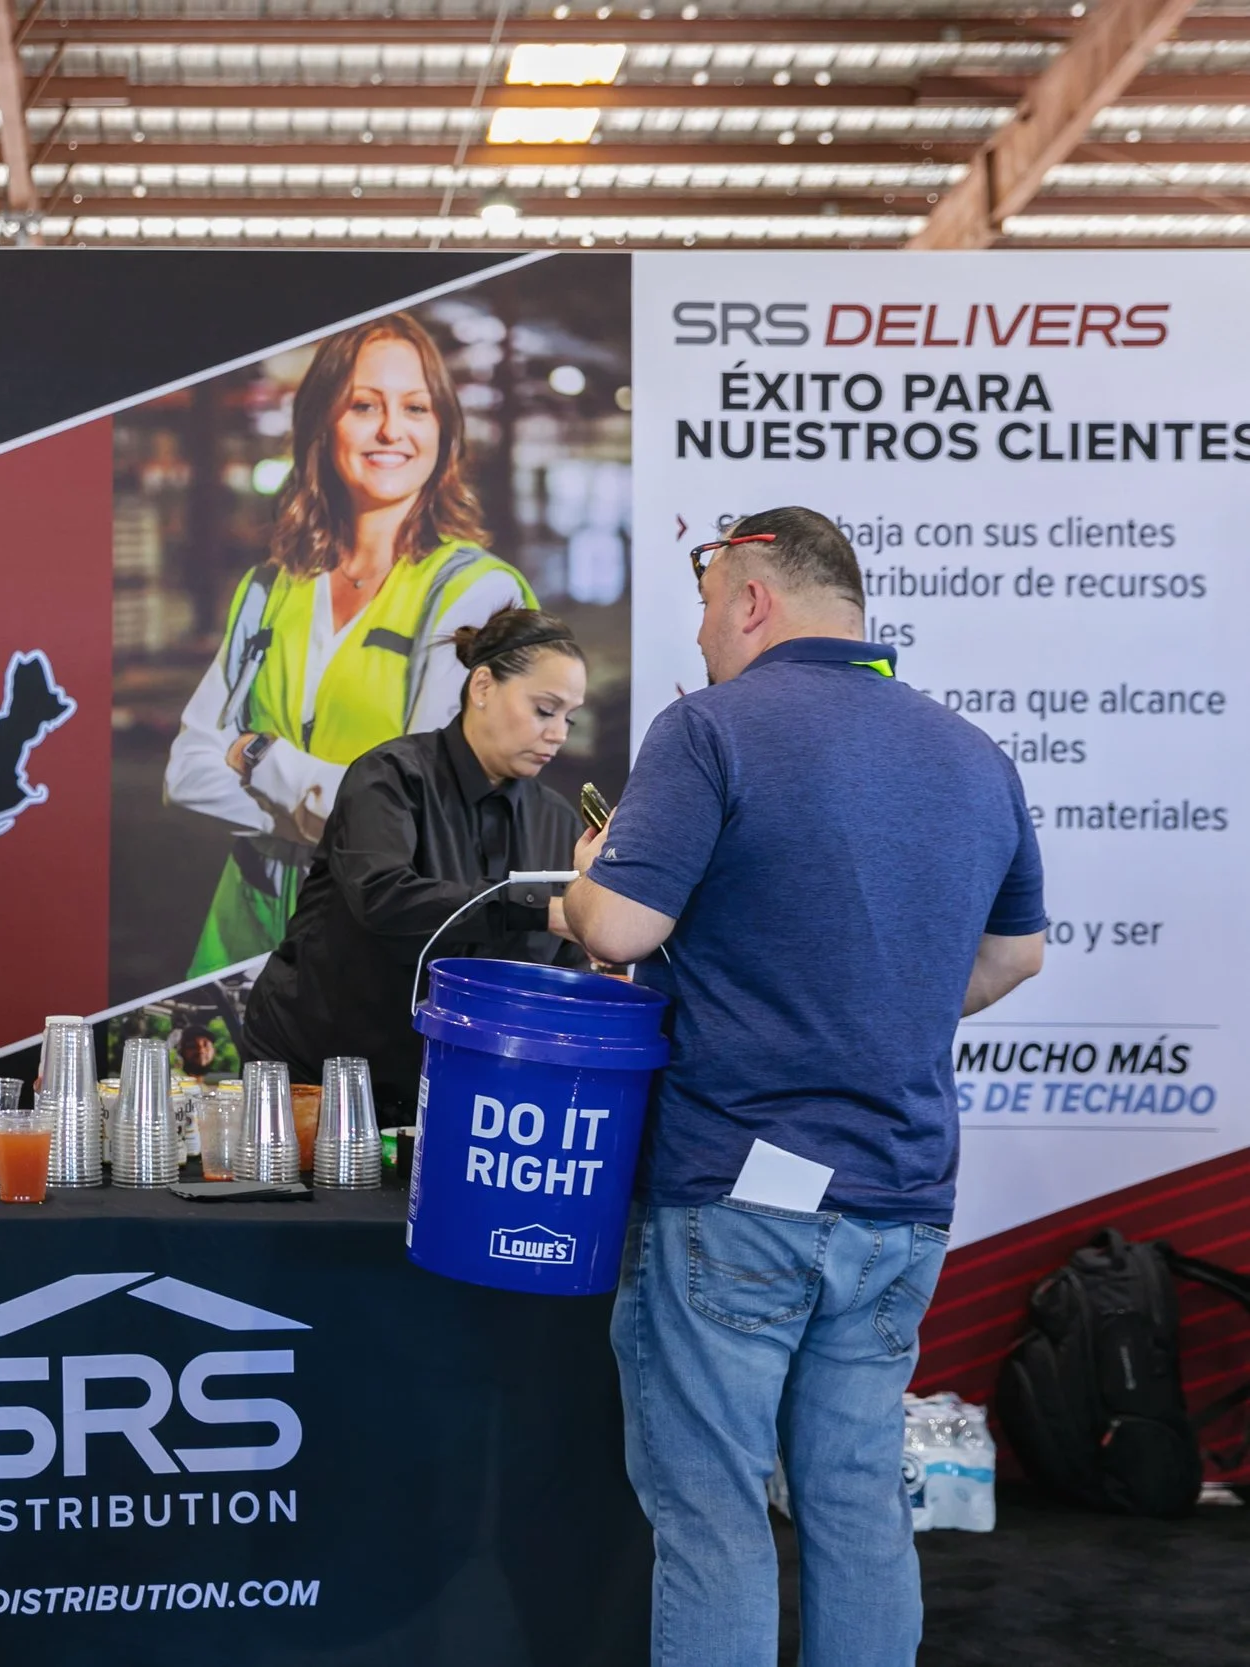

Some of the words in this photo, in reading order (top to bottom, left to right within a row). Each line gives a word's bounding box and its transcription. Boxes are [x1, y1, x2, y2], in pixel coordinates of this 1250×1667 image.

[673, 301, 810, 346] SRS
[824, 303, 1170, 347] DELIVERS
[721, 360, 884, 412] ÉXITO
[903, 373, 1054, 413] PARA
[676, 419, 979, 460] NUESTROS
[839, 516, 903, 554] baja
[914, 521, 974, 548] con
[983, 522, 1038, 548] sus
[1048, 516, 1176, 548] clientes
[864, 566, 1004, 598] tribuidor
[1012, 567, 1055, 598] de
[1065, 574, 1207, 599] recursos
[871, 616, 915, 646] les
[944, 688, 1016, 716] para
[1027, 688, 1090, 721] que
[1100, 683, 1225, 715] alcance
[1056, 799, 1229, 831] materiales
[1084, 921, 1103, 953] y
[1112, 921, 1163, 946] ser
[955, 1042, 1097, 1074] MUCHO
[1107, 1034, 1191, 1075] MÁS
[957, 1081, 975, 1113] S
[983, 1081, 1033, 1113] DE
[1042, 1082, 1217, 1115] TECHADO
[471, 1094, 545, 1146] DO
[561, 1108, 609, 1151] IT
[466, 1146, 603, 1196] RIGHT
[499, 1235, 567, 1260] LOWE'S
